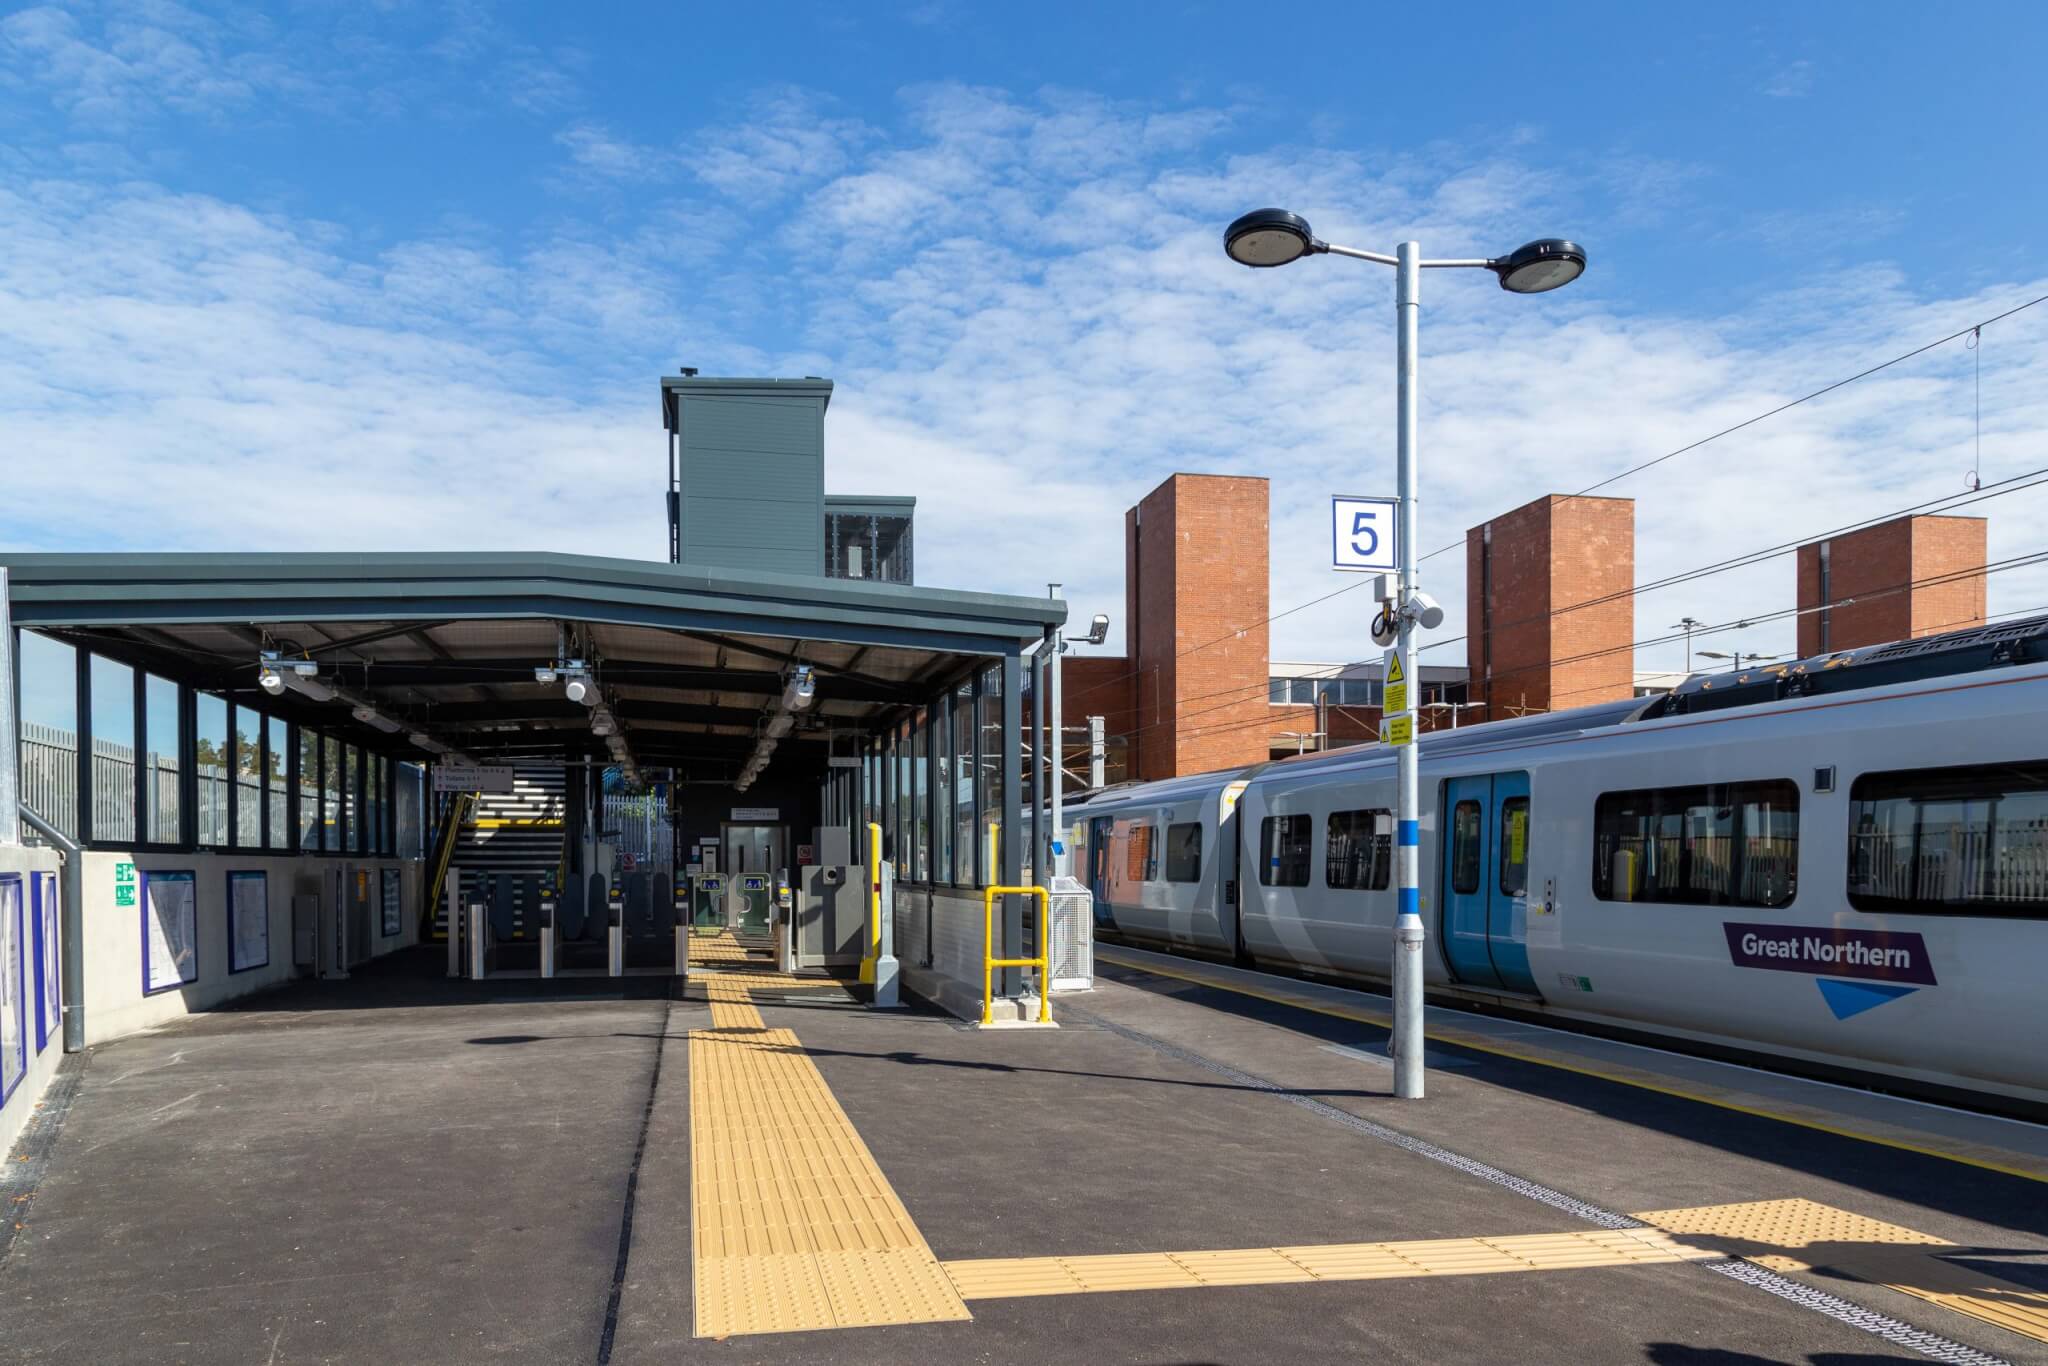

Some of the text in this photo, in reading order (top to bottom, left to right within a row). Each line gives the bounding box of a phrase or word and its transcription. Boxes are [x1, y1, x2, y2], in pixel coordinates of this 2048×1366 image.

[1351, 511, 1378, 556] 5
[1742, 933, 1911, 969] Great Northern
